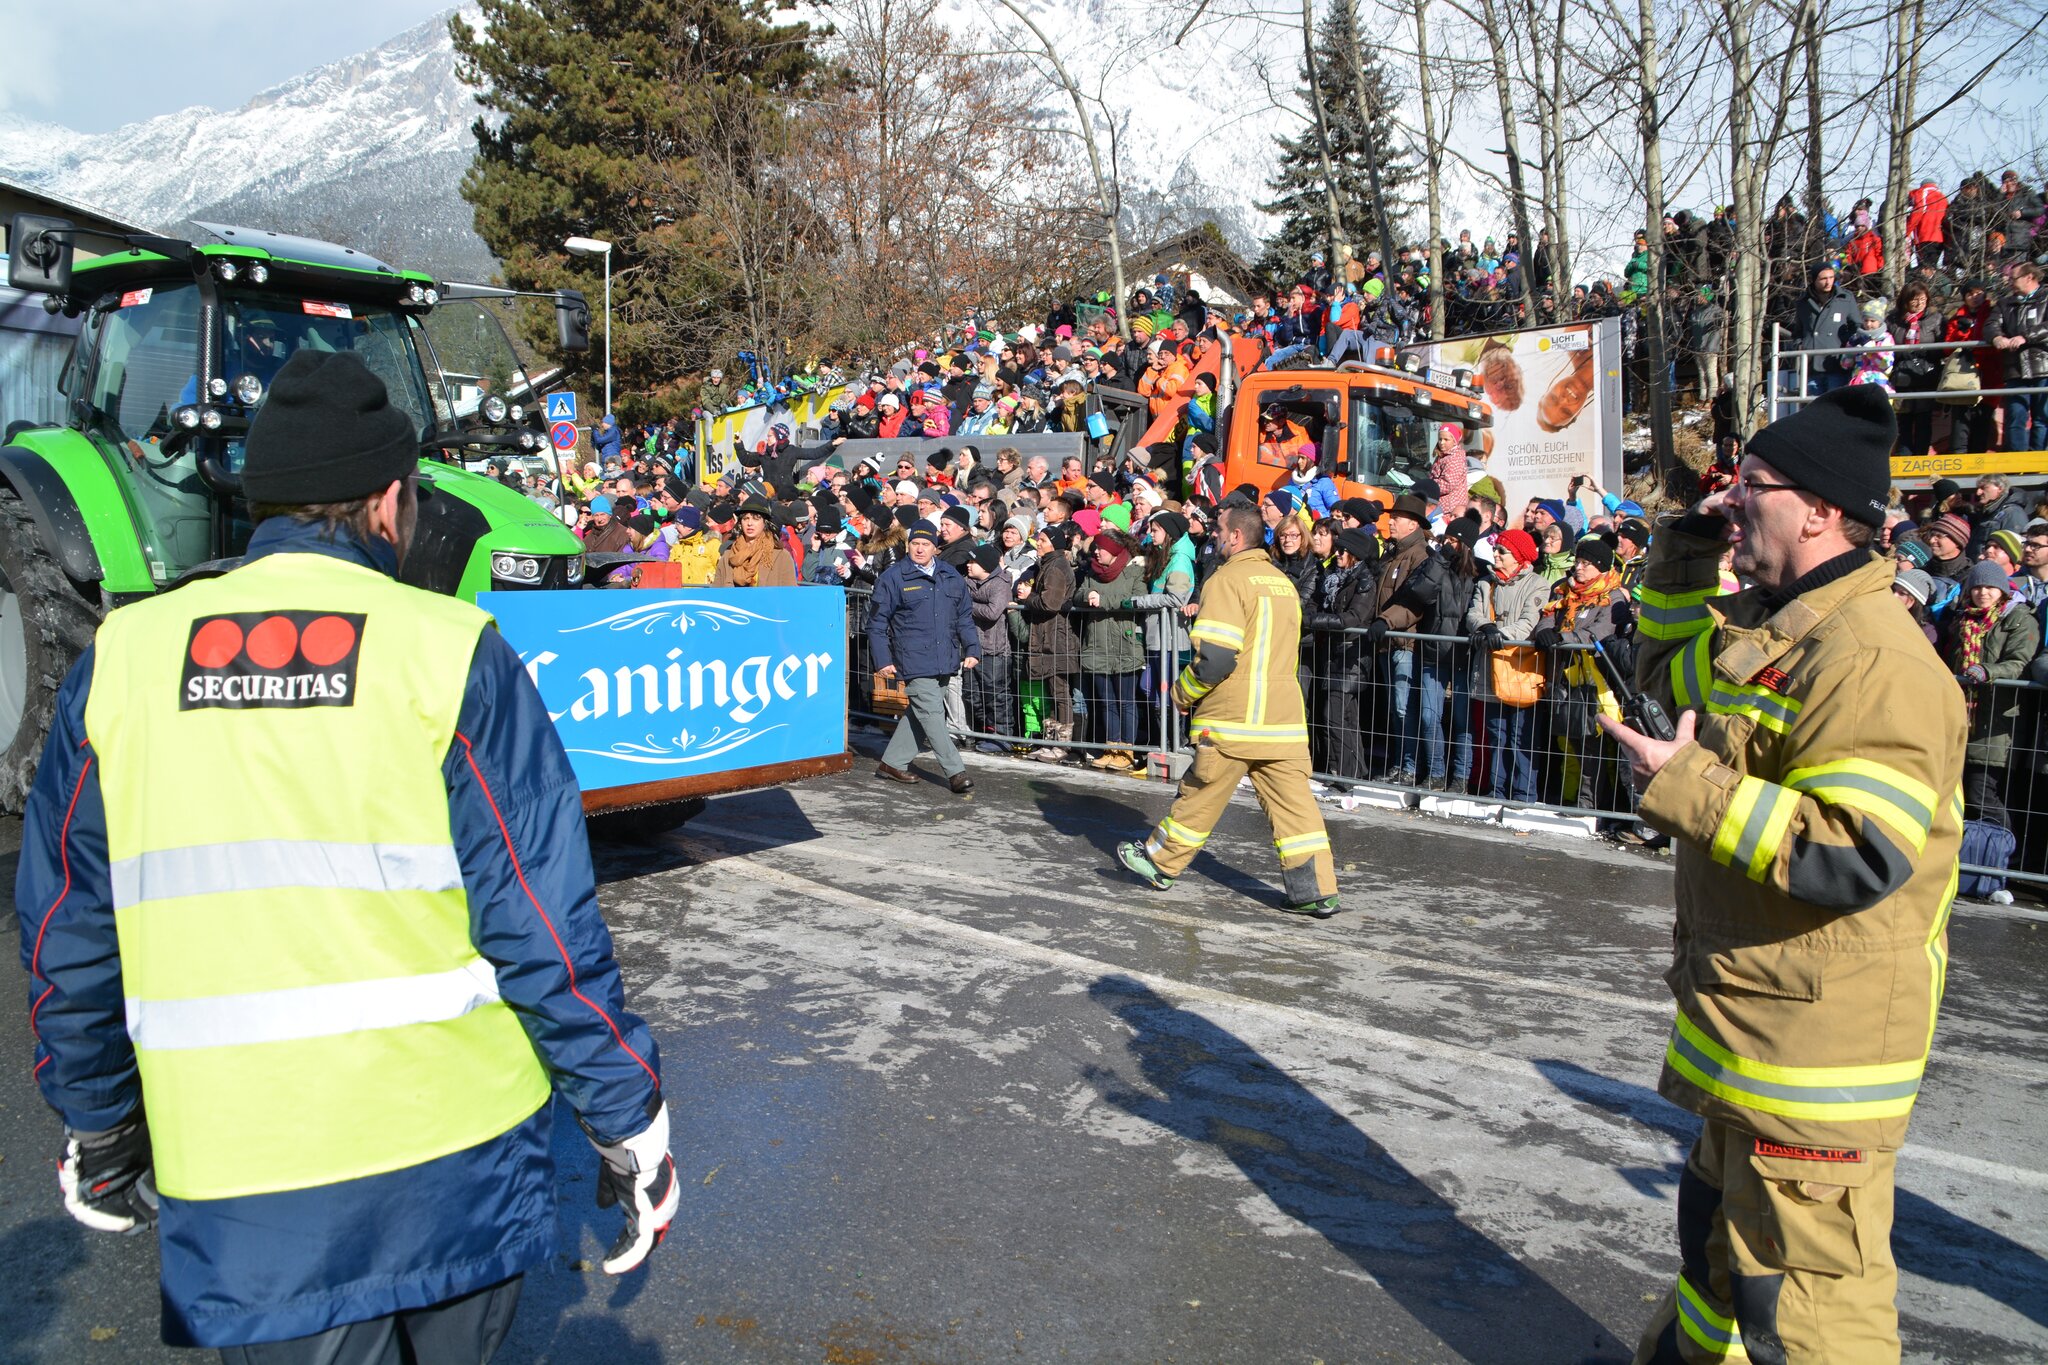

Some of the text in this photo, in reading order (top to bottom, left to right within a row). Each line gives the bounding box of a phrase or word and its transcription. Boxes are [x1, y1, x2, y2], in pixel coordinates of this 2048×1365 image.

[1552, 334, 1575, 344] LICHT
[1508, 441, 1569, 456] SCHÖN, EUCH
[1507, 452, 1585, 467] WIEDERZUSEHEN!
[1902, 458, 1963, 473] ZARGES
[187, 673, 347, 702] SECURITAS
